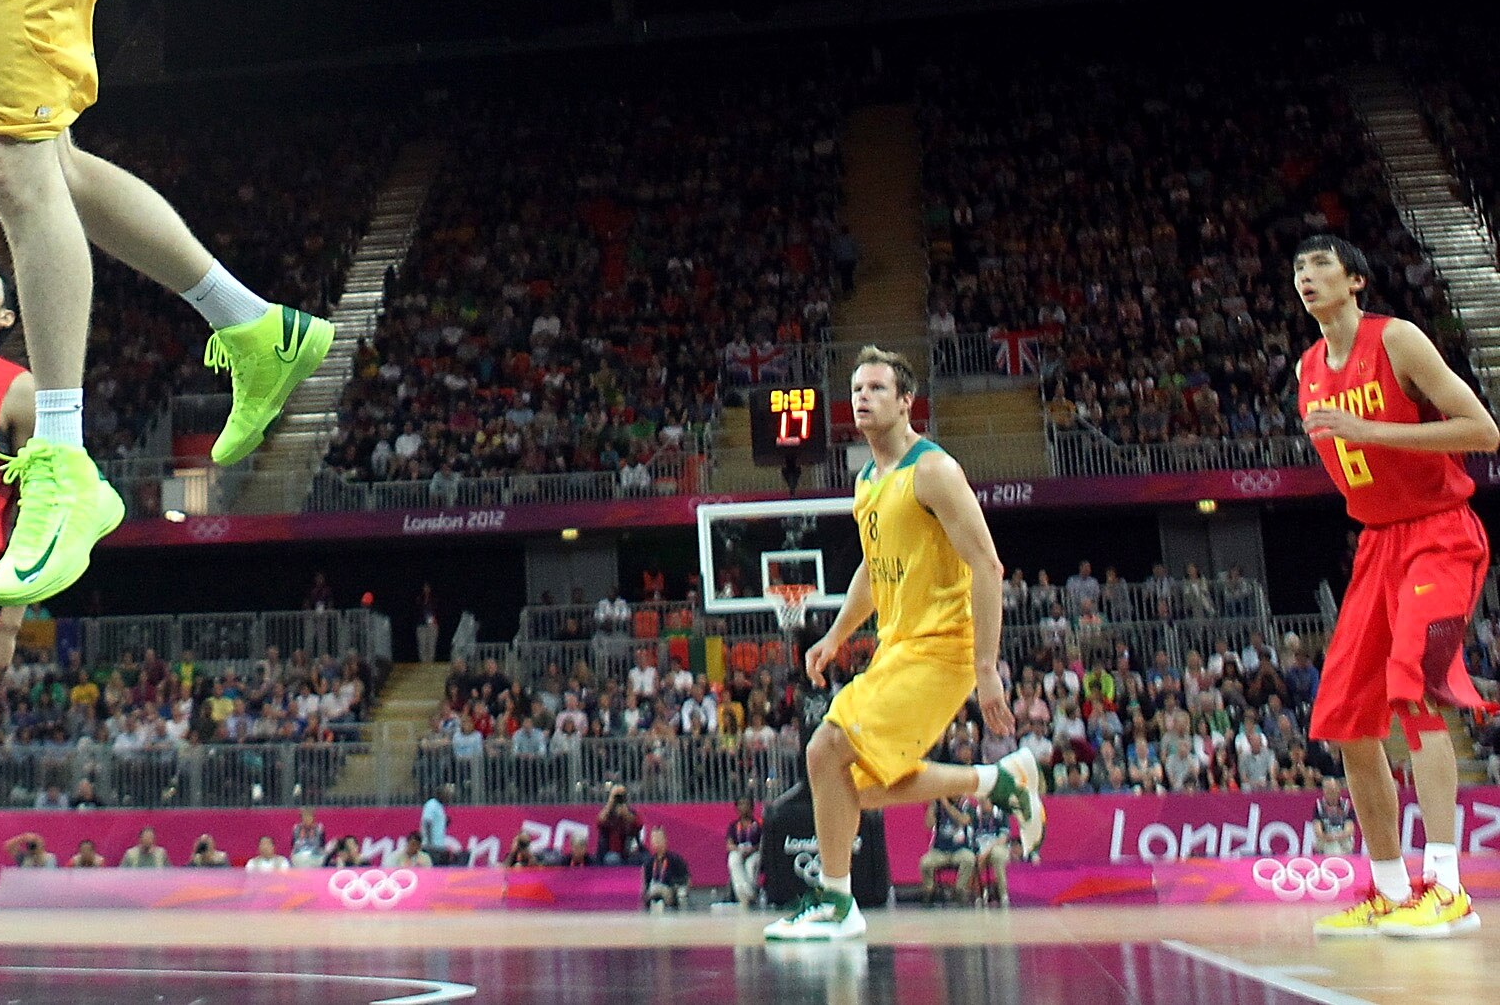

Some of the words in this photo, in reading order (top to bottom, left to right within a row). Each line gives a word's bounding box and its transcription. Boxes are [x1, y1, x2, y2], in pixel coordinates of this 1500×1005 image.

[770, 389, 815, 412] 9:53
[780, 410, 810, 439] 17
[1334, 436, 1374, 489] 6
[992, 482, 1033, 505] 2012
[403, 511, 464, 533] London
[467, 510, 506, 529] 2012
[869, 510, 878, 542] 8
[783, 834, 820, 854] Lond
